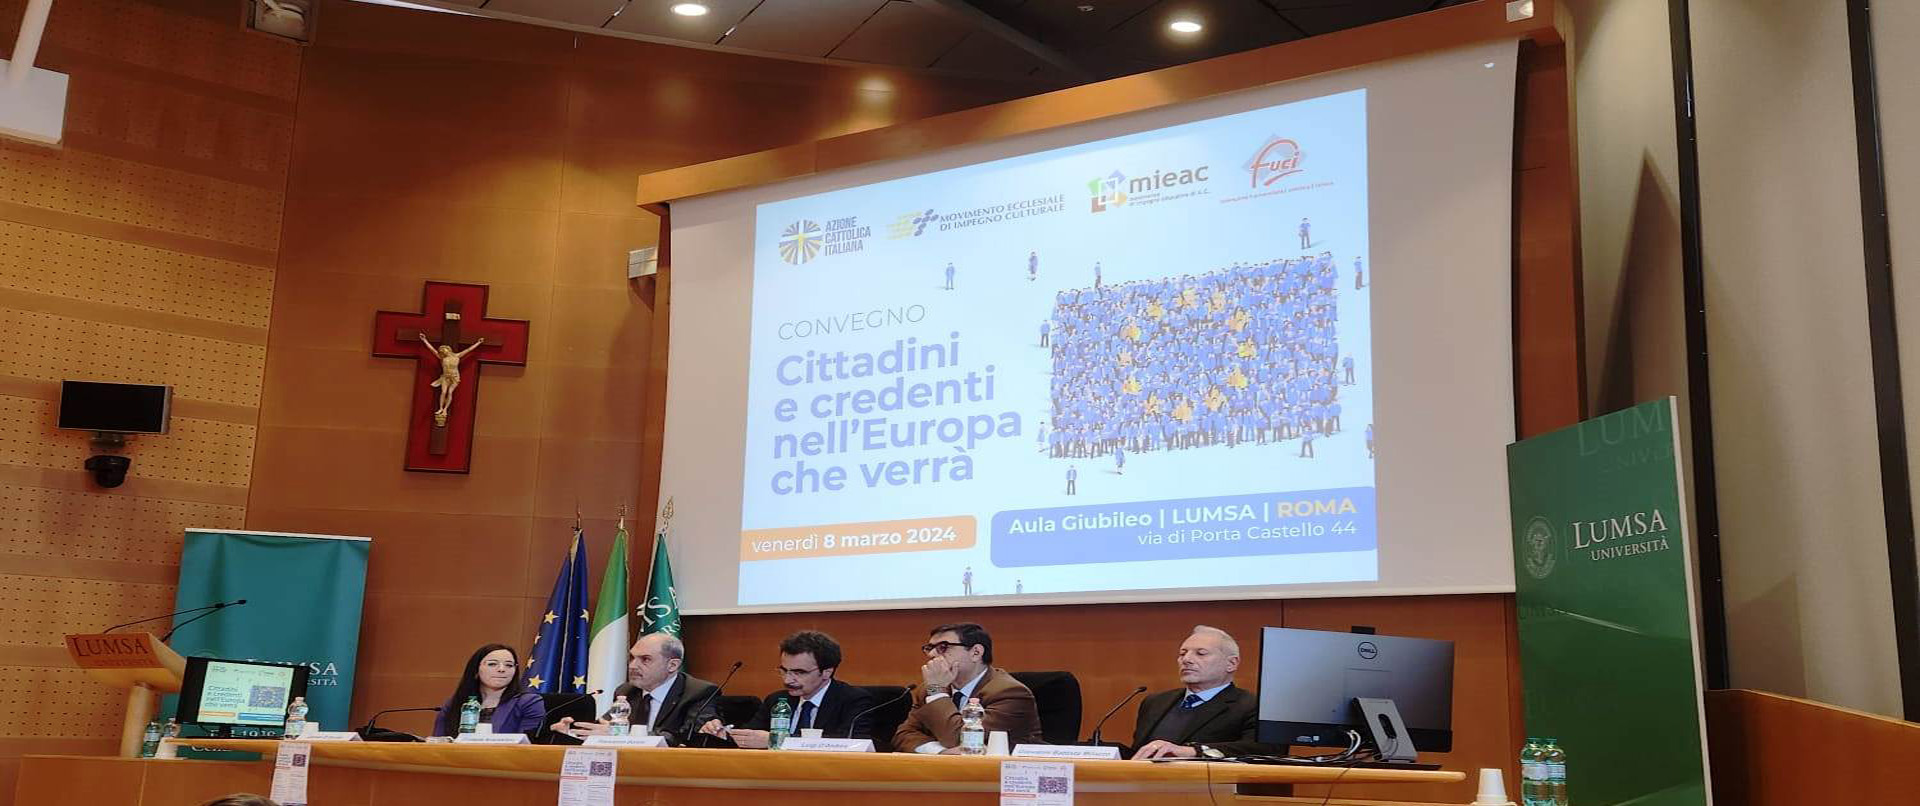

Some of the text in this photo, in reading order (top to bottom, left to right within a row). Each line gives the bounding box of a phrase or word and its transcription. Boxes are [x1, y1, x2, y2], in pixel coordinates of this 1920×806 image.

[1250, 138, 1300, 188] fuci
[1129, 165, 1208, 193] mieac
[940, 193, 1065, 222] MOVIMENTO ECCLESIALE
[940, 203, 1065, 231] DI IMPEGNO CULTURALE
[825, 216, 857, 232] AZIONE
[825, 226, 871, 244] CATTOLICA
[825, 240, 864, 256] ITALIANA
[778, 304, 925, 340] CONVEGNO
[776, 331, 959, 386] Cittadini
[774, 364, 995, 422] e credenti
[773, 411, 1022, 459] nell'Europa
[770, 445, 974, 495] che verrà
[1009, 516, 1056, 534] Aula
[1062, 511, 1153, 531] Giubileo
[1172, 504, 1257, 524] LUMSA
[1277, 497, 1359, 518] ROMA
[1572, 509, 1669, 549] LUMSA
[752, 526, 957, 553] venerdì 8 marzo 2024
[1138, 520, 1358, 545] via di Porta Castello 44
[1591, 536, 1670, 561] UNIVERSITÀ
[71, 637, 148, 656] LUMSA
